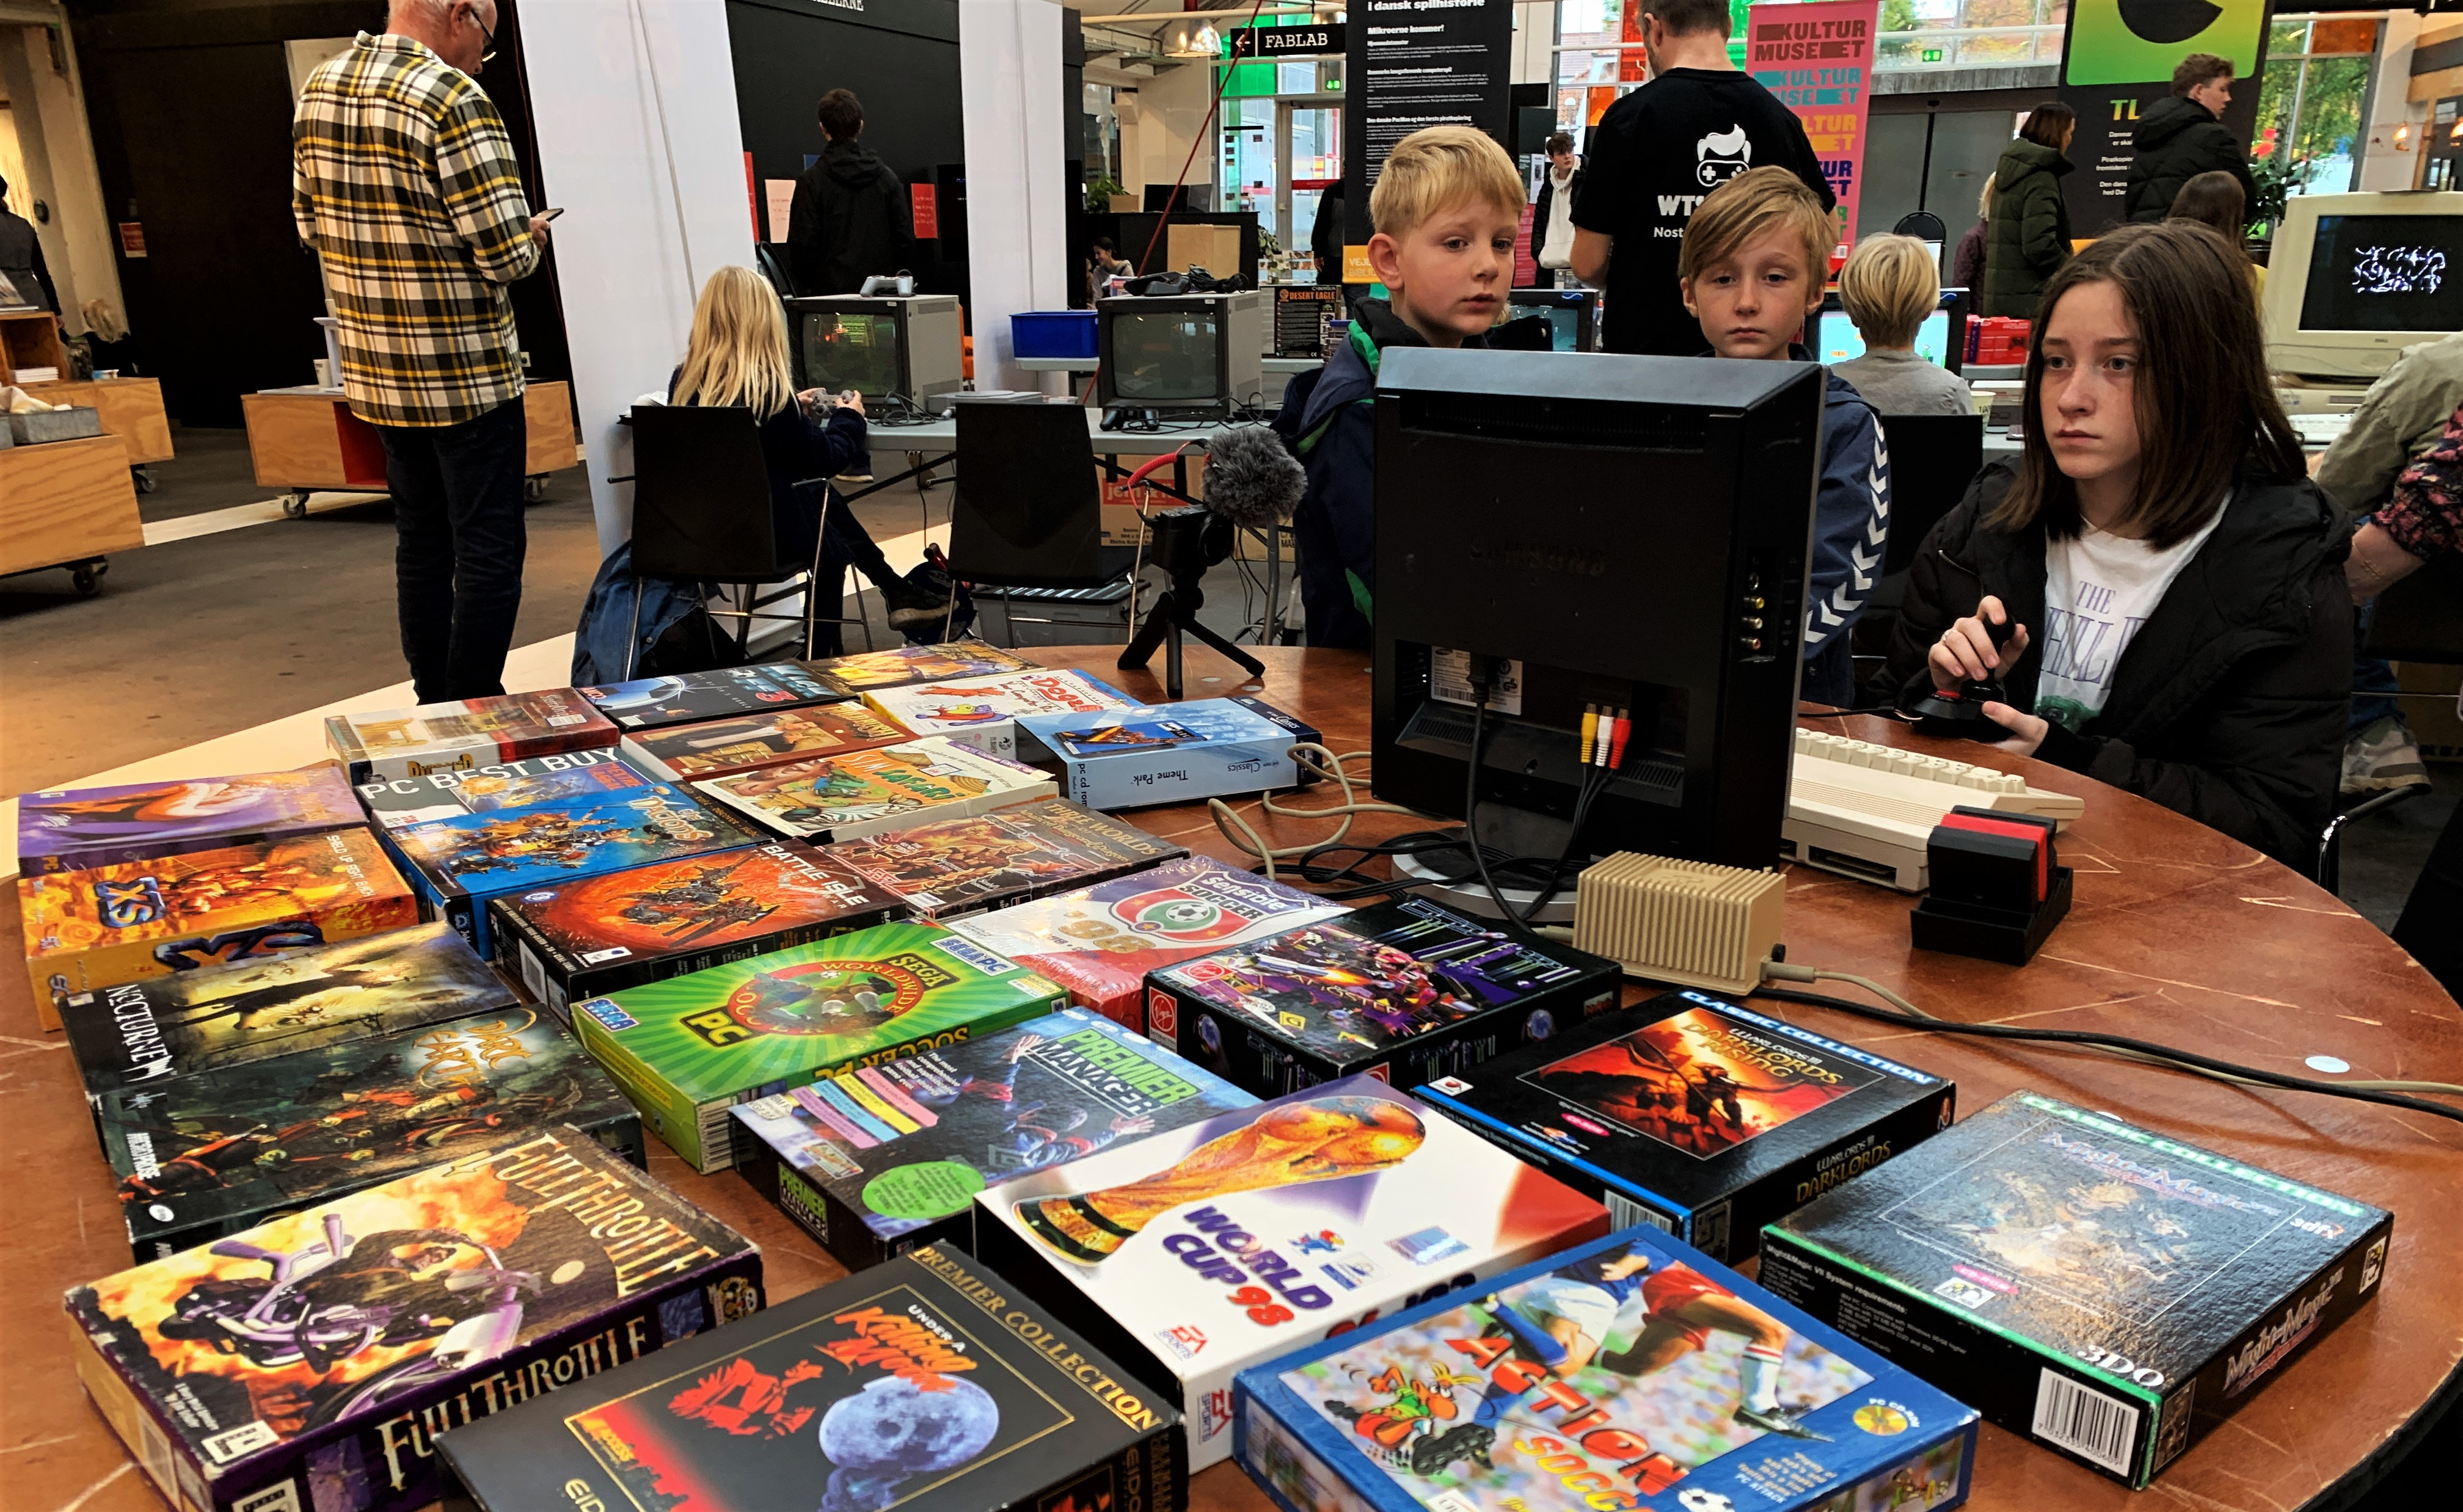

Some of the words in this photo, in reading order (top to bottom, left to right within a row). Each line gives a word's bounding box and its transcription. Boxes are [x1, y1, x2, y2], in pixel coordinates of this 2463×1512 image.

[1374, 1, 1412, 10] dansk
[1265, 33, 1328, 48] FABLAB
[1779, 20, 1866, 40] KULTUR
[1754, 40, 1865, 61] MUSEET
[1778, 67, 1861, 87] KULTUR
[1775, 87, 1860, 106] USEET
[1657, 195, 1699, 216] WT
[1289, 292, 1315, 300] DESERT
[1315, 291, 1335, 300] EAGLE
[2076, 581, 2116, 614] THE
[755, 690, 799, 702] 3
[758, 665, 841, 699] KICK
[359, 780, 420, 799] PC
[427, 759, 535, 790] BEST
[539, 747, 620, 772] BUY
[840, 754, 894, 772] SIM
[1077, 763, 1086, 776] pc
[1133, 774, 1153, 785] Park
[1157, 769, 1188, 780] Theme
[1227, 761, 1261, 772] Classics
[1079, 778, 1090, 789] cd
[1043, 803, 1095, 825] THREE
[1089, 821, 1162, 855] WORLDS
[338, 855, 346, 864] UP
[762, 845, 830, 881] BATTLE
[820, 881, 870, 906] ISLE
[1178, 884, 1263, 920] SOCCER
[1202, 875, 1286, 912] Sensible
[889, 954, 949, 987] SEGA
[939, 939, 986, 966] SEGA
[979, 956, 1010, 975] PC
[821, 962, 918, 1016] WORLDWIDE
[106, 984, 173, 1064] NOCTURNE
[587, 1005, 621, 1028] SPORTS
[688, 1012, 750, 1044] PC
[1679, 990, 1776, 1027] CLASSIC
[1776, 1025, 1936, 1085] COLLECTION
[1681, 1023, 1845, 1085] DARKLORDS
[1729, 1027, 1809, 1064] WARLORDS
[929, 1052, 943, 1062] The
[1057, 1028, 1197, 1105] PREMIER
[1699, 1041, 1793, 1078] RISING
[496, 1133, 593, 1198] FULL
[1796, 1140, 1891, 1204] DARKLORDS
[1816, 1140, 1866, 1172] WARLORDS
[2024, 1096, 2151, 1145] CLASSIC
[2150, 1139, 2366, 1218] COLLECTION
[779, 1162, 827, 1221] PREMIER
[563, 1170, 720, 1299] THROTTLE
[2289, 1217, 2335, 1239] 3dfx
[1183, 1205, 1334, 1310] WORLD
[1162, 1234, 1247, 1285] CUP
[1226, 1286, 1294, 1328] 98
[1959, 1267, 2010, 1291] CD-ROM
[908, 1304, 954, 1347] UNDER
[951, 1340, 966, 1353] A
[913, 1246, 1009, 1313] PREMIER
[1005, 1311, 1162, 1431] COLLECTION
[1158, 1329, 1195, 1359] SPORTS
[471, 1315, 648, 1416] THROTTLE
[2077, 1344, 2164, 1387] 3DO
[1202, 1392, 1211, 1443] SPORTS
[1445, 1336, 1690, 1497] ACTION
[1869, 1397, 1886, 1406] PC
[1888, 1401, 1921, 1428] CD-ROM
[1513, 1436, 1643, 1512] SOCC
[1734, 1474, 1751, 1484] PC
[1749, 1481, 1787, 1504] ATTACK
